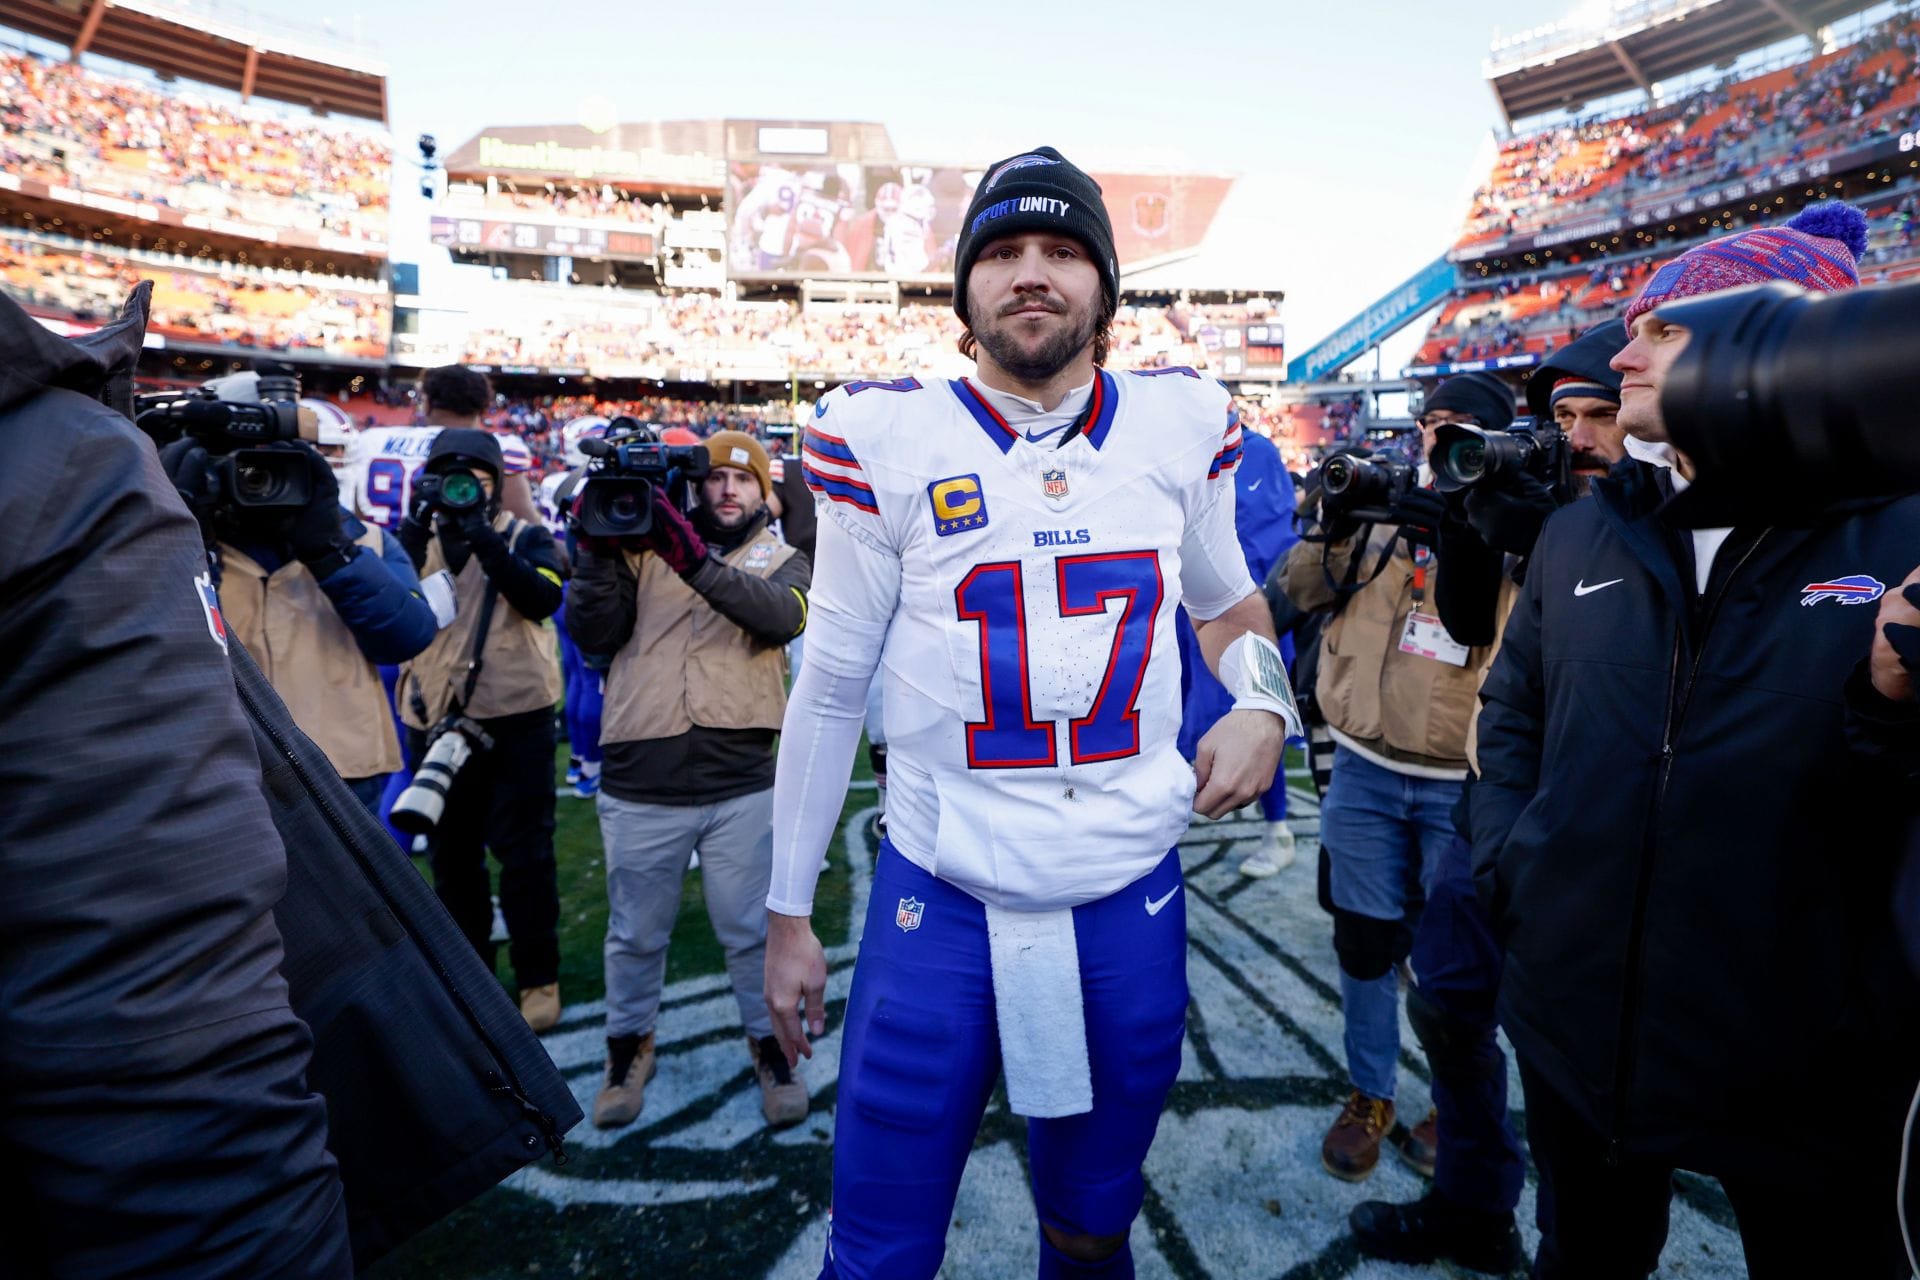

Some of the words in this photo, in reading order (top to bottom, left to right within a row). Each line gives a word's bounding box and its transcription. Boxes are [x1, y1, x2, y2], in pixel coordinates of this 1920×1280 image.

[480, 137, 639, 178] Huntington
[971, 196, 1071, 234] OPPORTUNITY
[1305, 282, 1420, 380] PROGRESSIVE
[932, 478, 981, 521] C
[1045, 480, 1067, 495] NFL
[1033, 529, 1091, 547] BILLS
[954, 549, 1164, 769] 17
